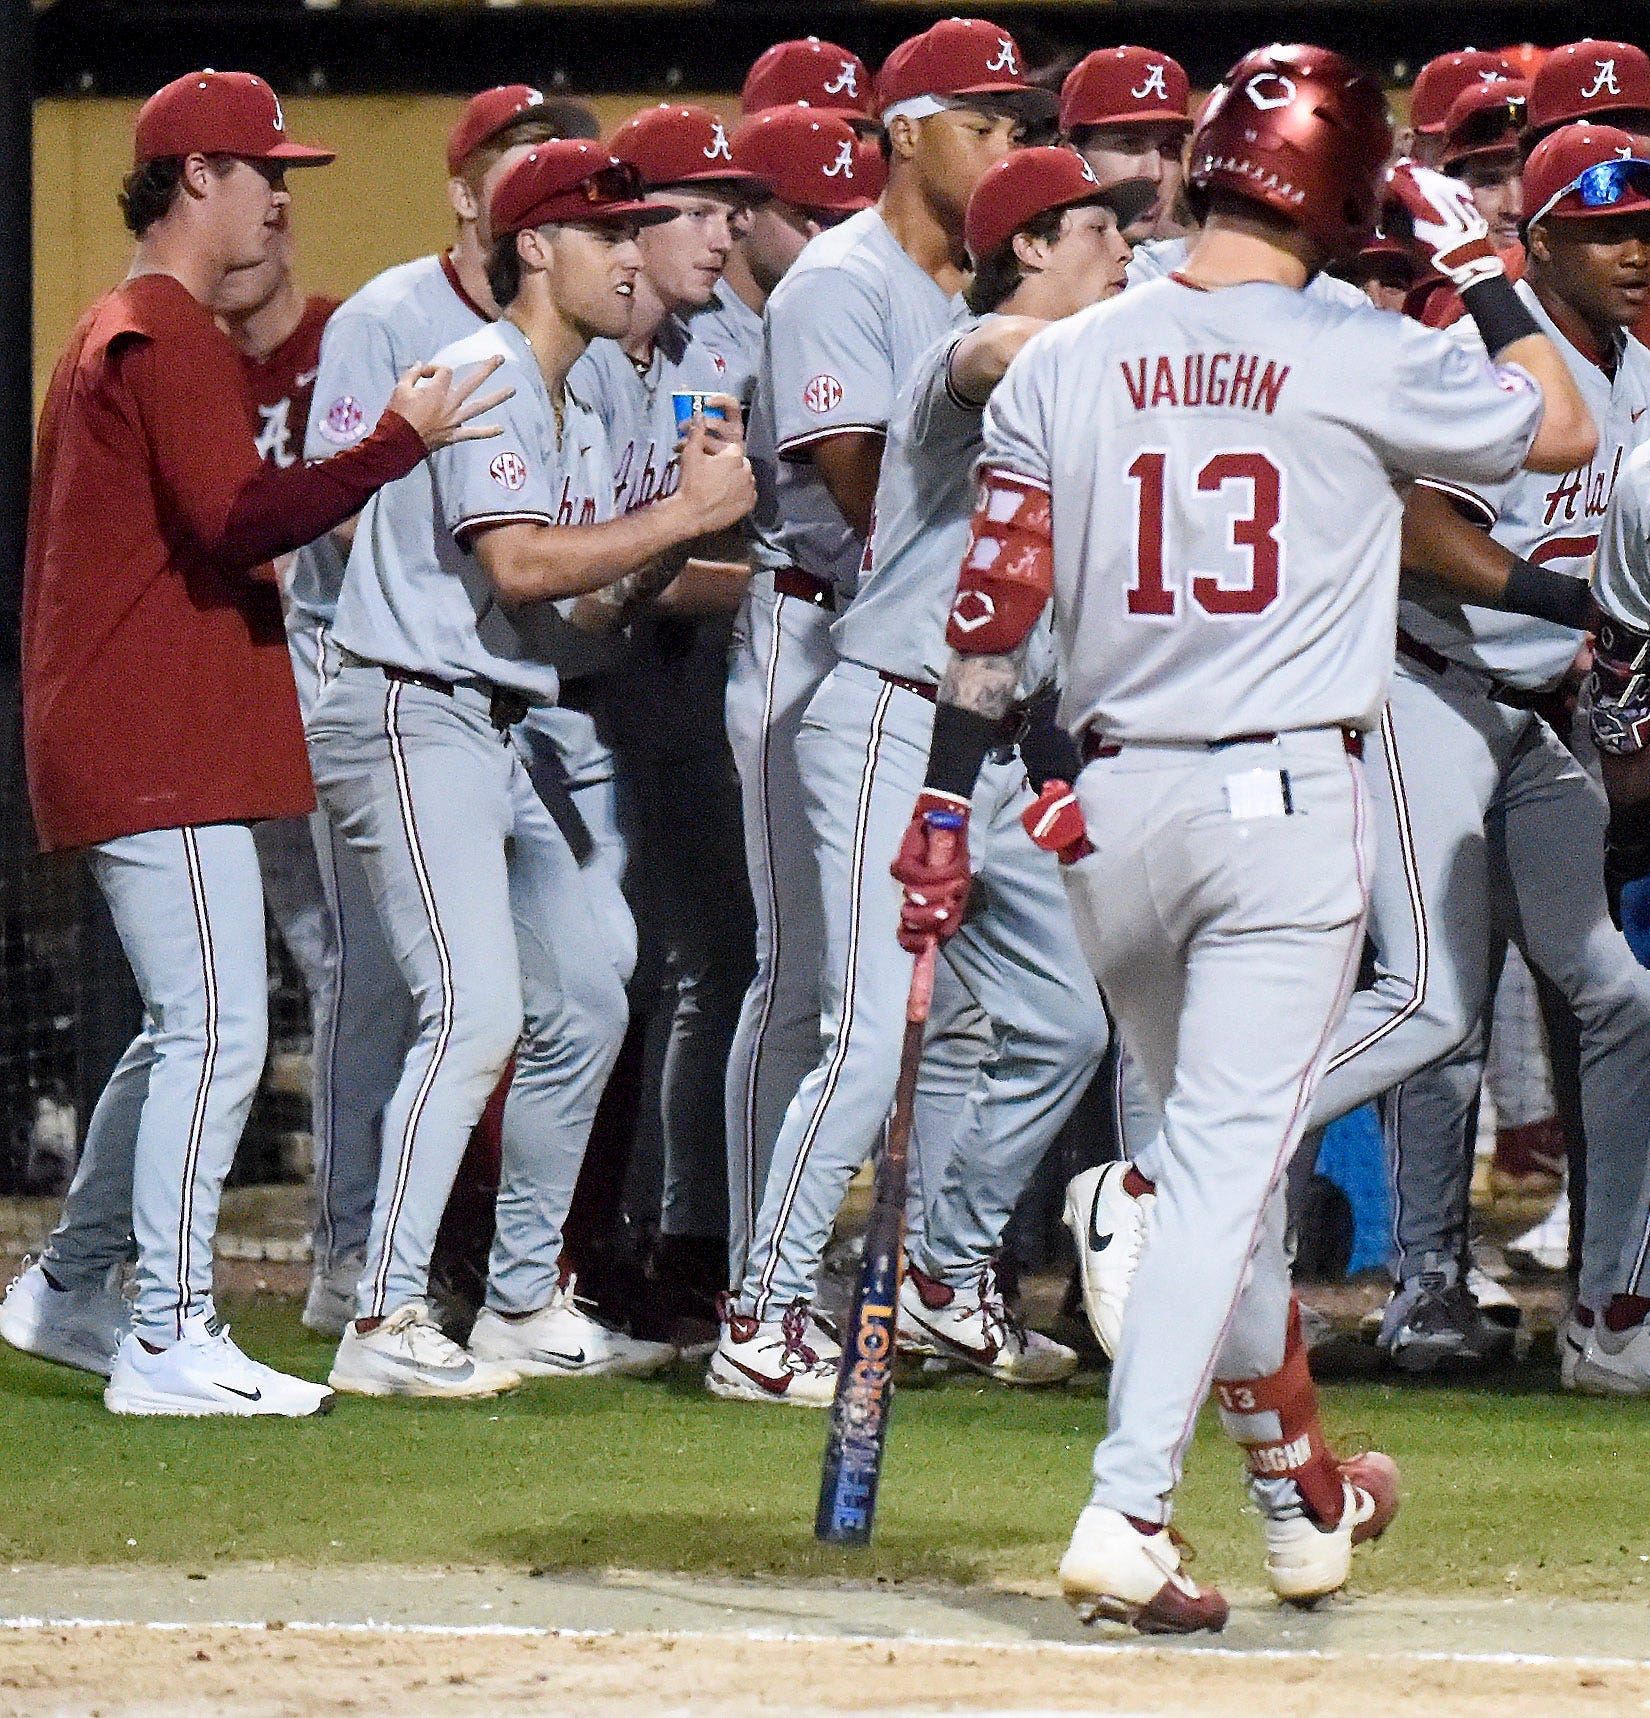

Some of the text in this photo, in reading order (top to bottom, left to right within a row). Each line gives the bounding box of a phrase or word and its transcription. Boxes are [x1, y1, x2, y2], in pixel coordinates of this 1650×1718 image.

[985, 37, 1018, 76] A
[823, 61, 859, 98] A
[1131, 64, 1168, 100] A
[1581, 59, 1621, 98] A
[703, 123, 733, 160] A
[822, 141, 853, 179] A
[804, 375, 843, 413] SEC
[1119, 352, 1291, 415] VAUGHN
[254, 397, 297, 468] A
[488, 452, 527, 492] SEC
[1125, 451, 1283, 617] 13
[1219, 1385, 1257, 1409] 13
